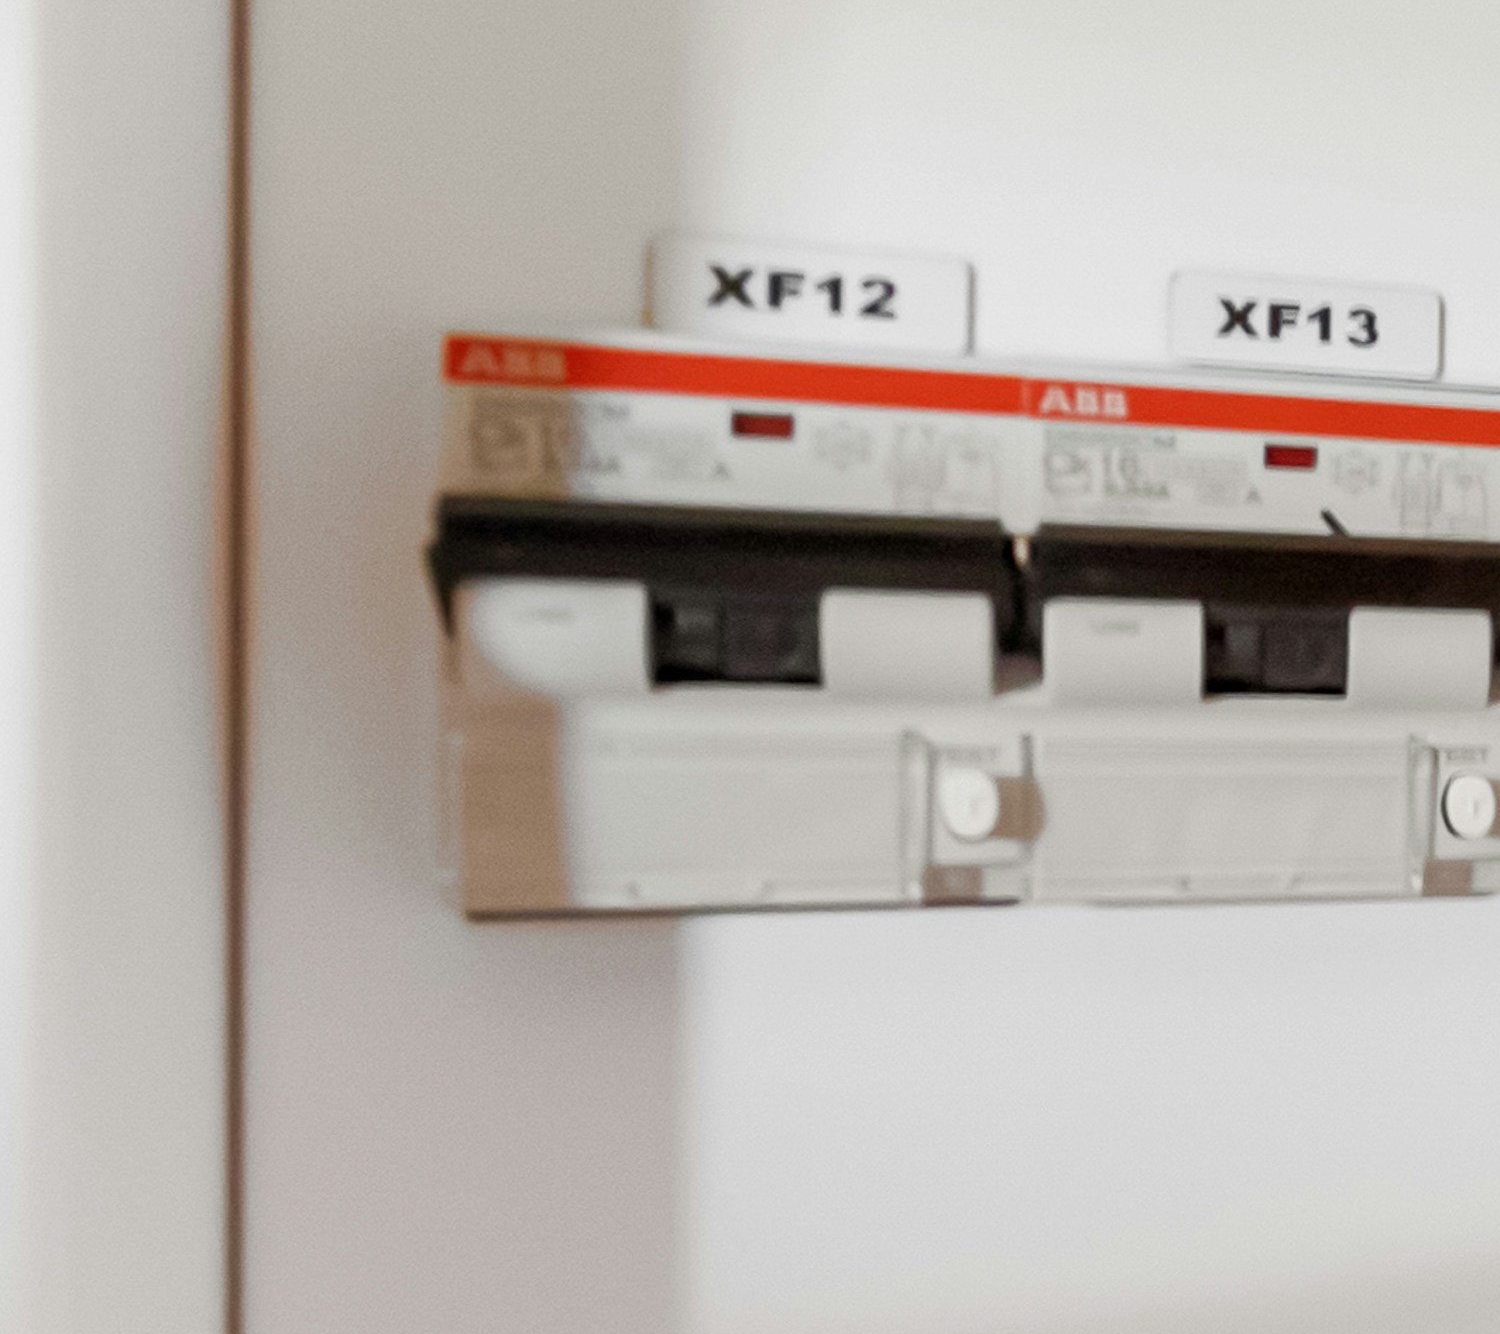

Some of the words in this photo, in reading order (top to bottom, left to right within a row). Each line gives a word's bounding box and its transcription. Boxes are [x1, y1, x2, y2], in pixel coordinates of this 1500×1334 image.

[706, 264, 897, 319] XF12
[1218, 298, 1379, 348] XF13
[460, 343, 567, 380] ABB
[1039, 385, 1128, 419] ABB
